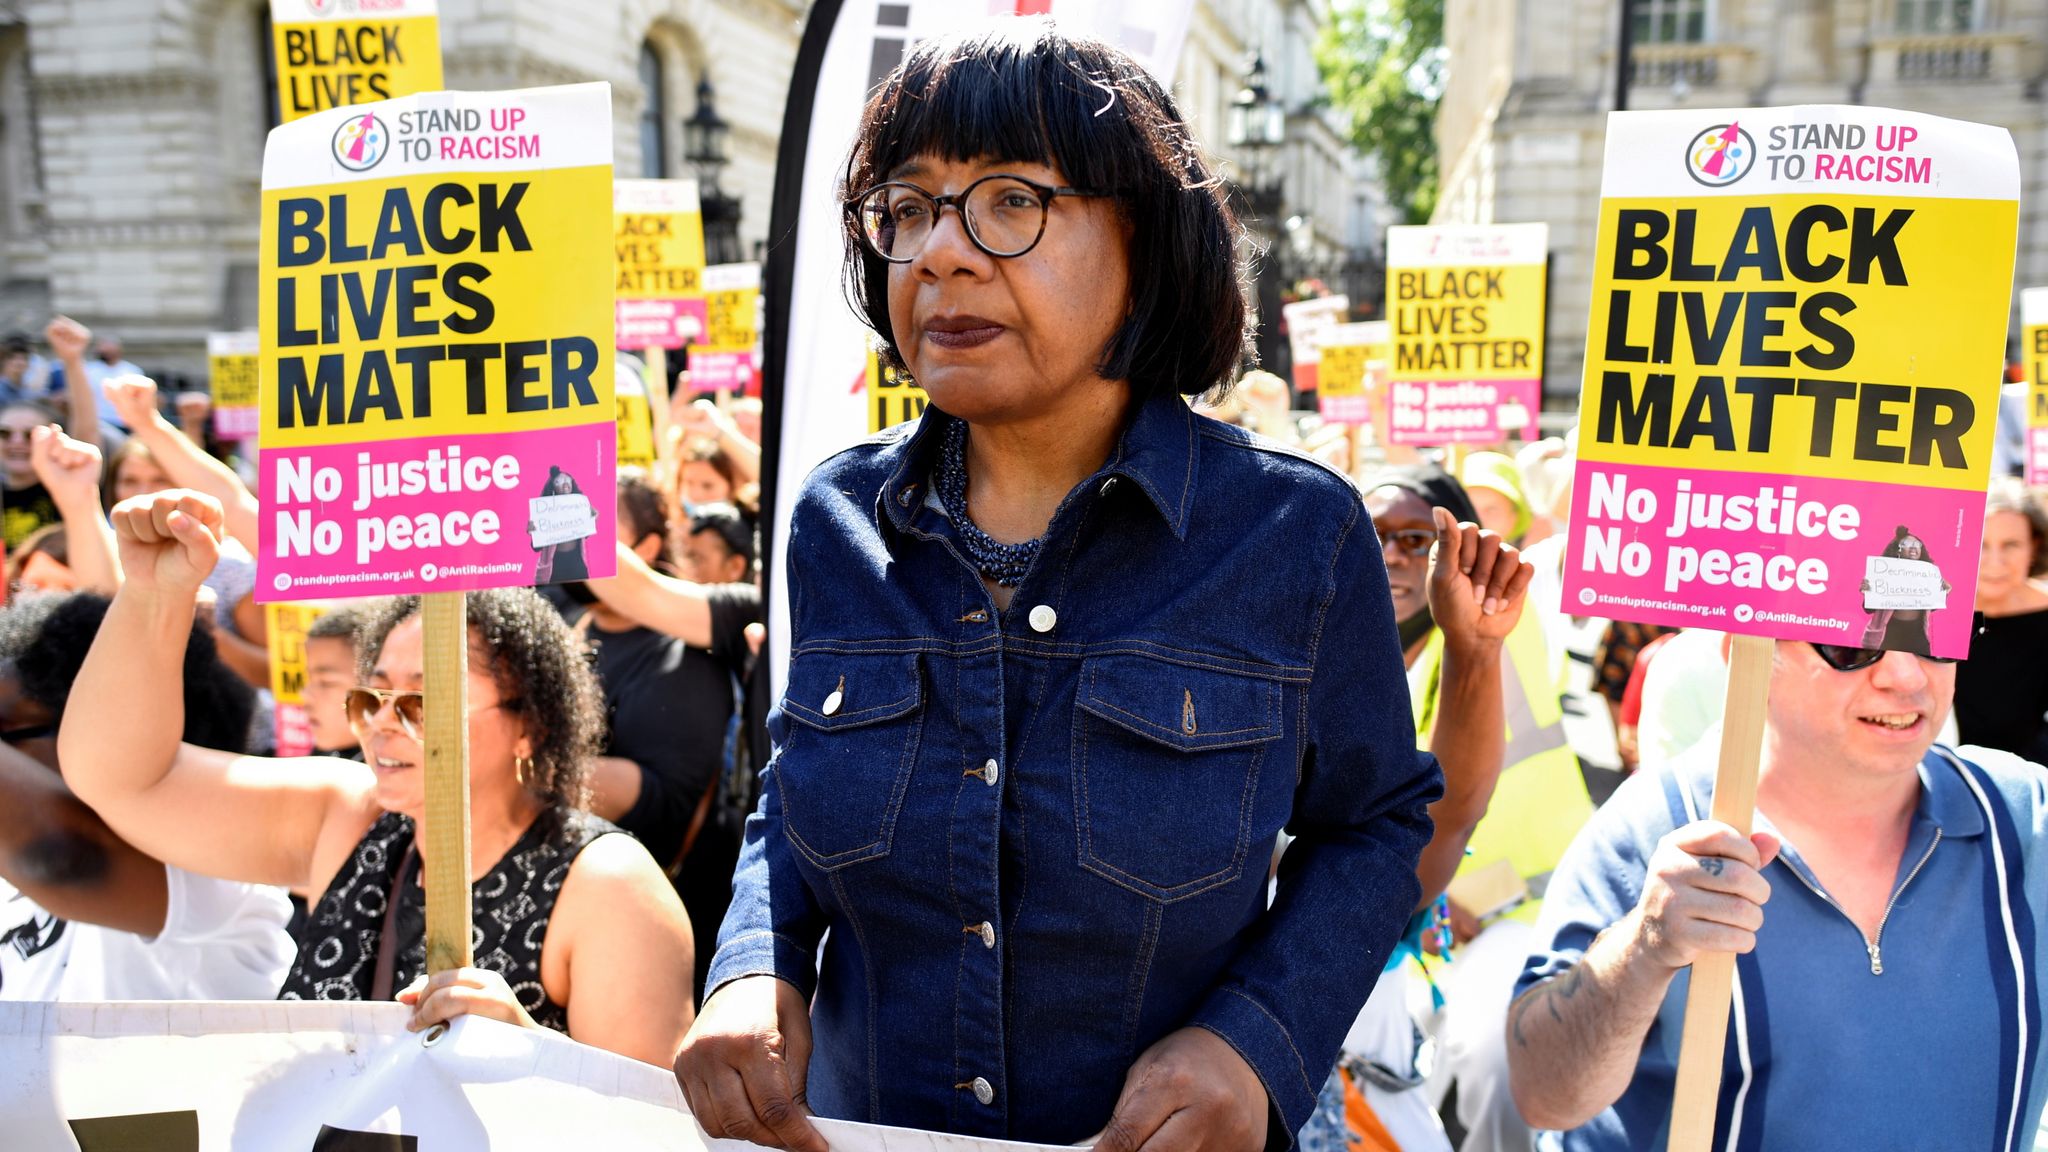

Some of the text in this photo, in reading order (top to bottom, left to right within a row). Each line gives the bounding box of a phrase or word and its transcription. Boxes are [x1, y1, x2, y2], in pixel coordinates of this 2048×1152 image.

[285, 26, 404, 67] BLACK
[399, 108, 526, 135] STAND UP
[1768, 123, 1918, 152] STAND UP
[399, 135, 541, 162] TO RACISM
[1766, 154, 1932, 184] TO RACISM
[277, 182, 533, 268] BLACK
[1612, 204, 1915, 287] BLACK
[616, 269, 697, 291] ATTER
[1397, 270, 1504, 300] BLACK
[277, 262, 496, 348] LIVES
[1397, 305, 1488, 336] LIVES
[1604, 289, 1858, 371] LIVES
[1397, 341, 1531, 372] MATTER
[277, 336, 600, 429] MATTER
[1596, 371, 1976, 469] MATTER
[276, 445, 520, 511] No justice
[1587, 472, 1861, 542] No justice
[276, 509, 500, 564] No peace
[293, 562, 523, 587] standuptoracism.org.uk @AntiRacismDay
[1581, 525, 1829, 595] No peace
[1598, 592, 1850, 632] standuptoracism.org.uk @AntiRacismDay
